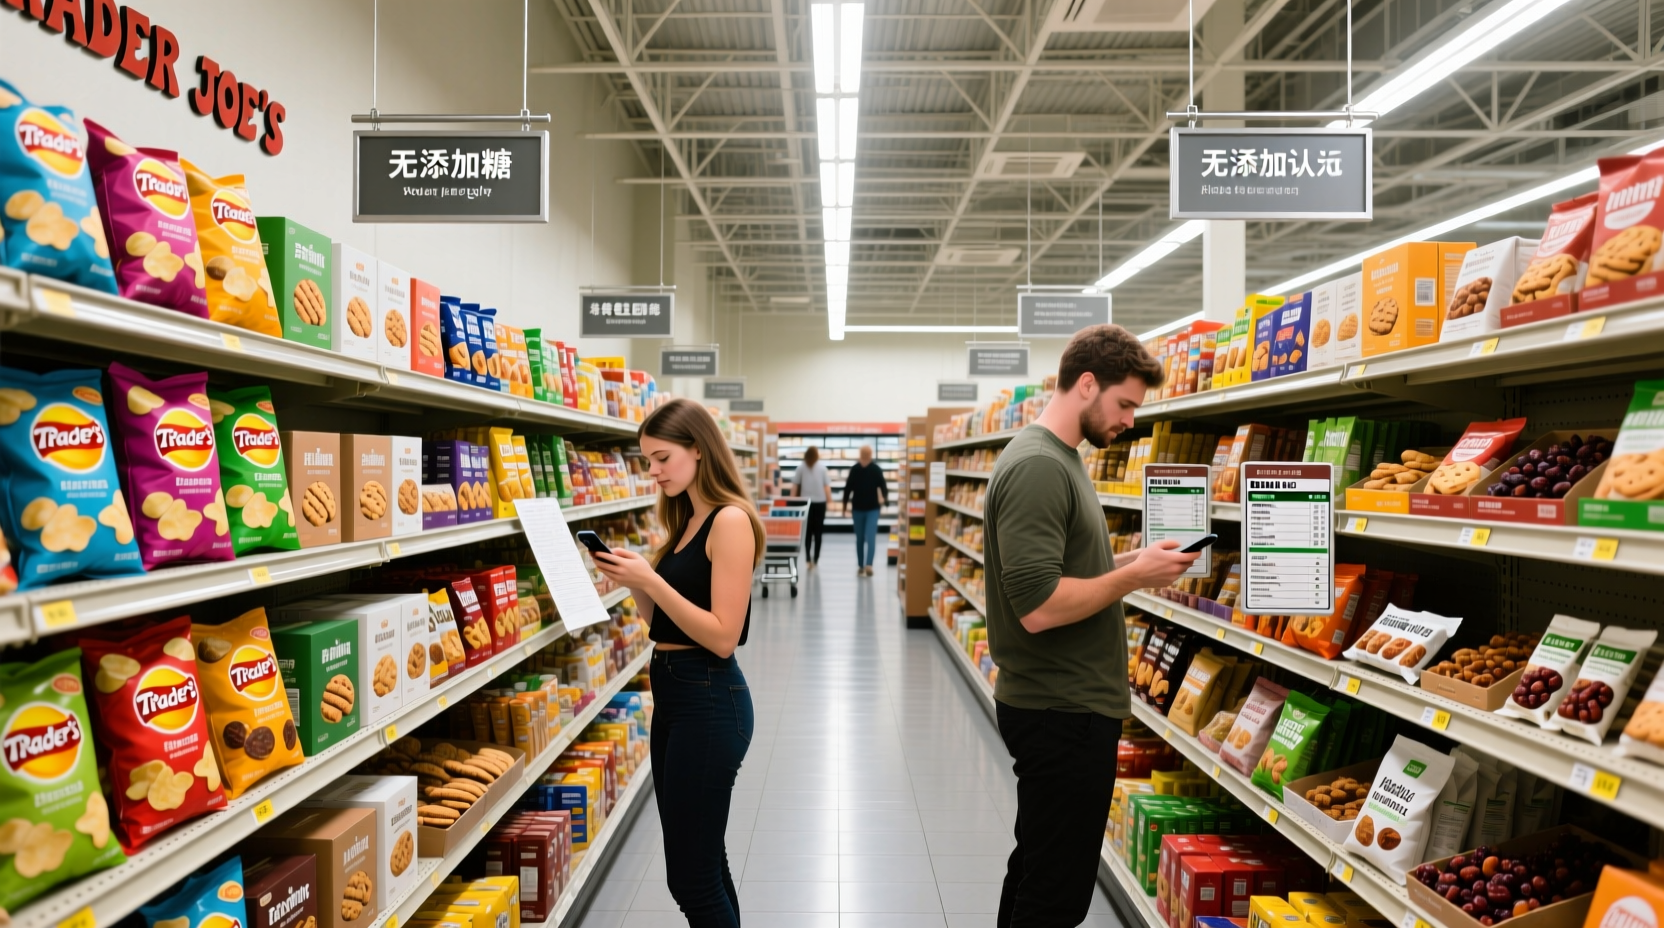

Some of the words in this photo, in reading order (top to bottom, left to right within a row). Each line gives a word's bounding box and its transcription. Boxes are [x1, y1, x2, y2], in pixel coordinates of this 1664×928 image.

[190, 56, 286, 156] JOE'S
[388, 147, 513, 180] 无添加糖
